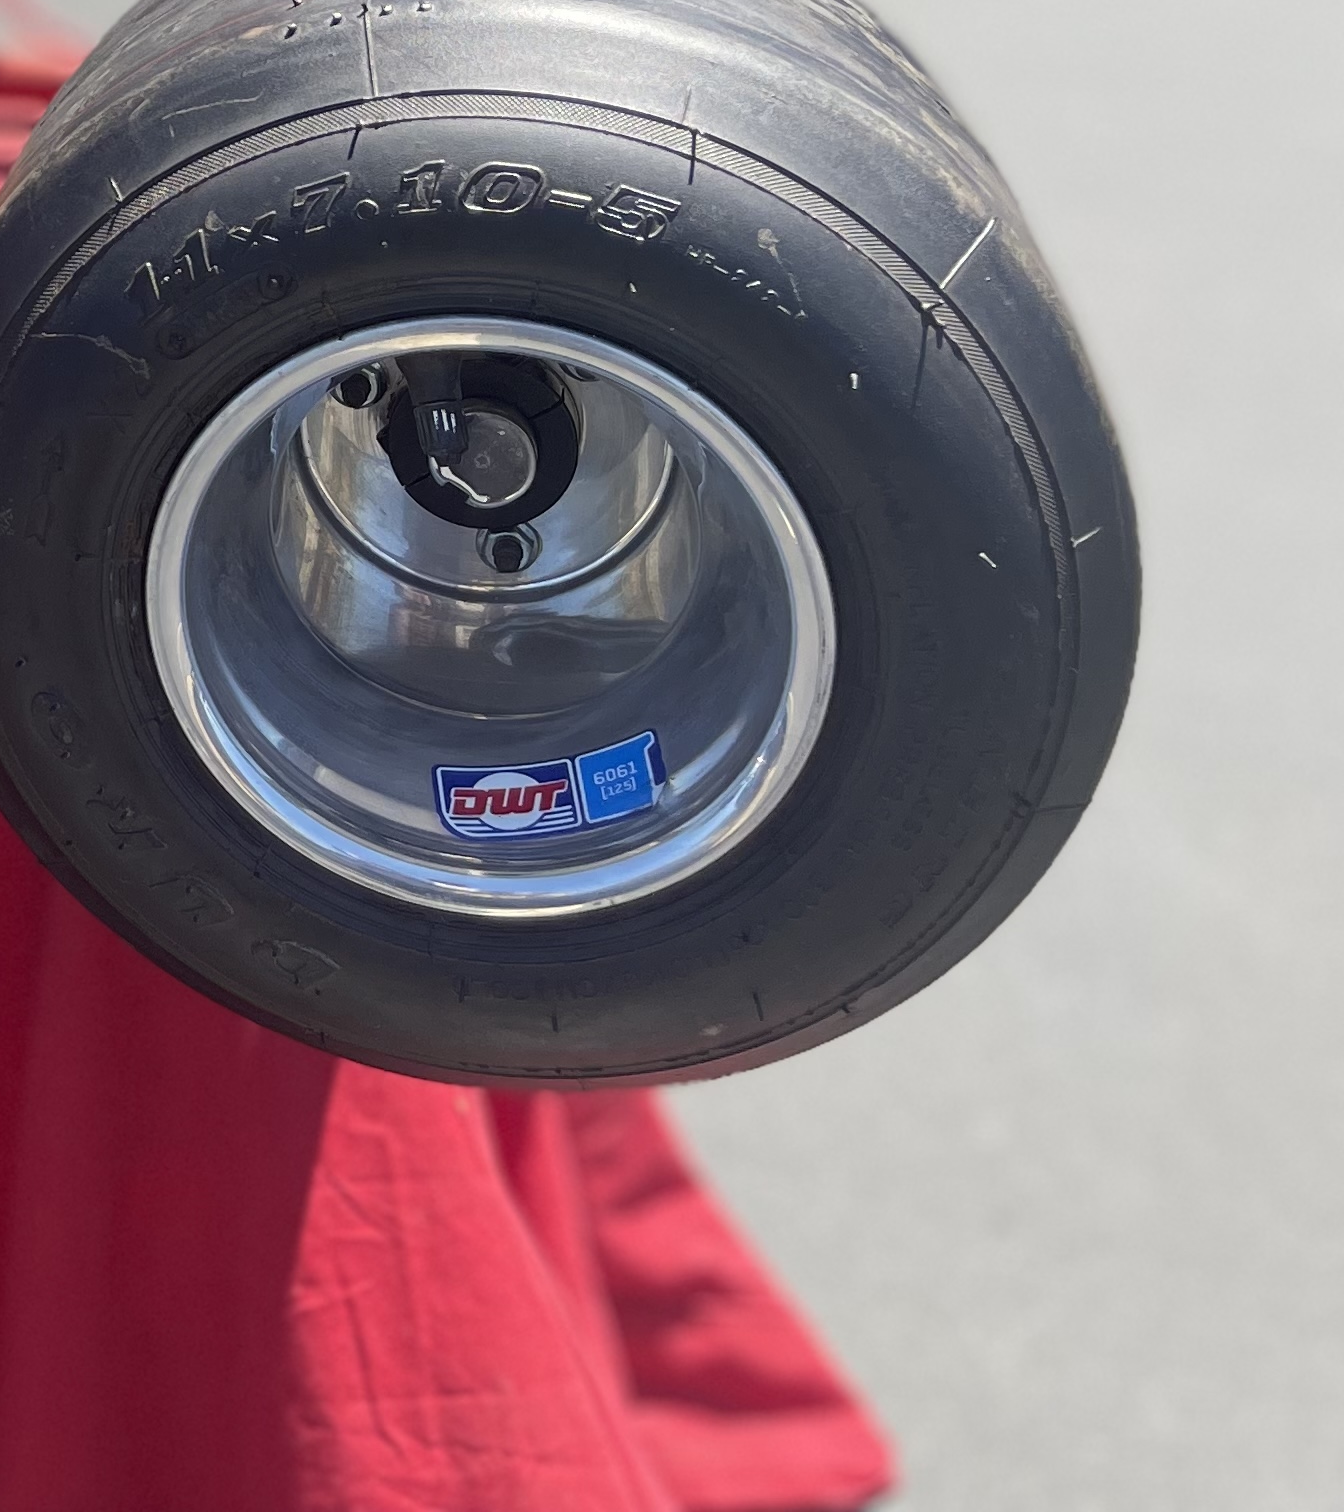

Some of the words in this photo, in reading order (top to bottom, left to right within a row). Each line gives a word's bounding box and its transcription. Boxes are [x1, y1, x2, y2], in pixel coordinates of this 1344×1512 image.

[593, 760, 639, 786] 6061
[449, 778, 569, 818] DWT
[600, 777, 637, 802] [125]
